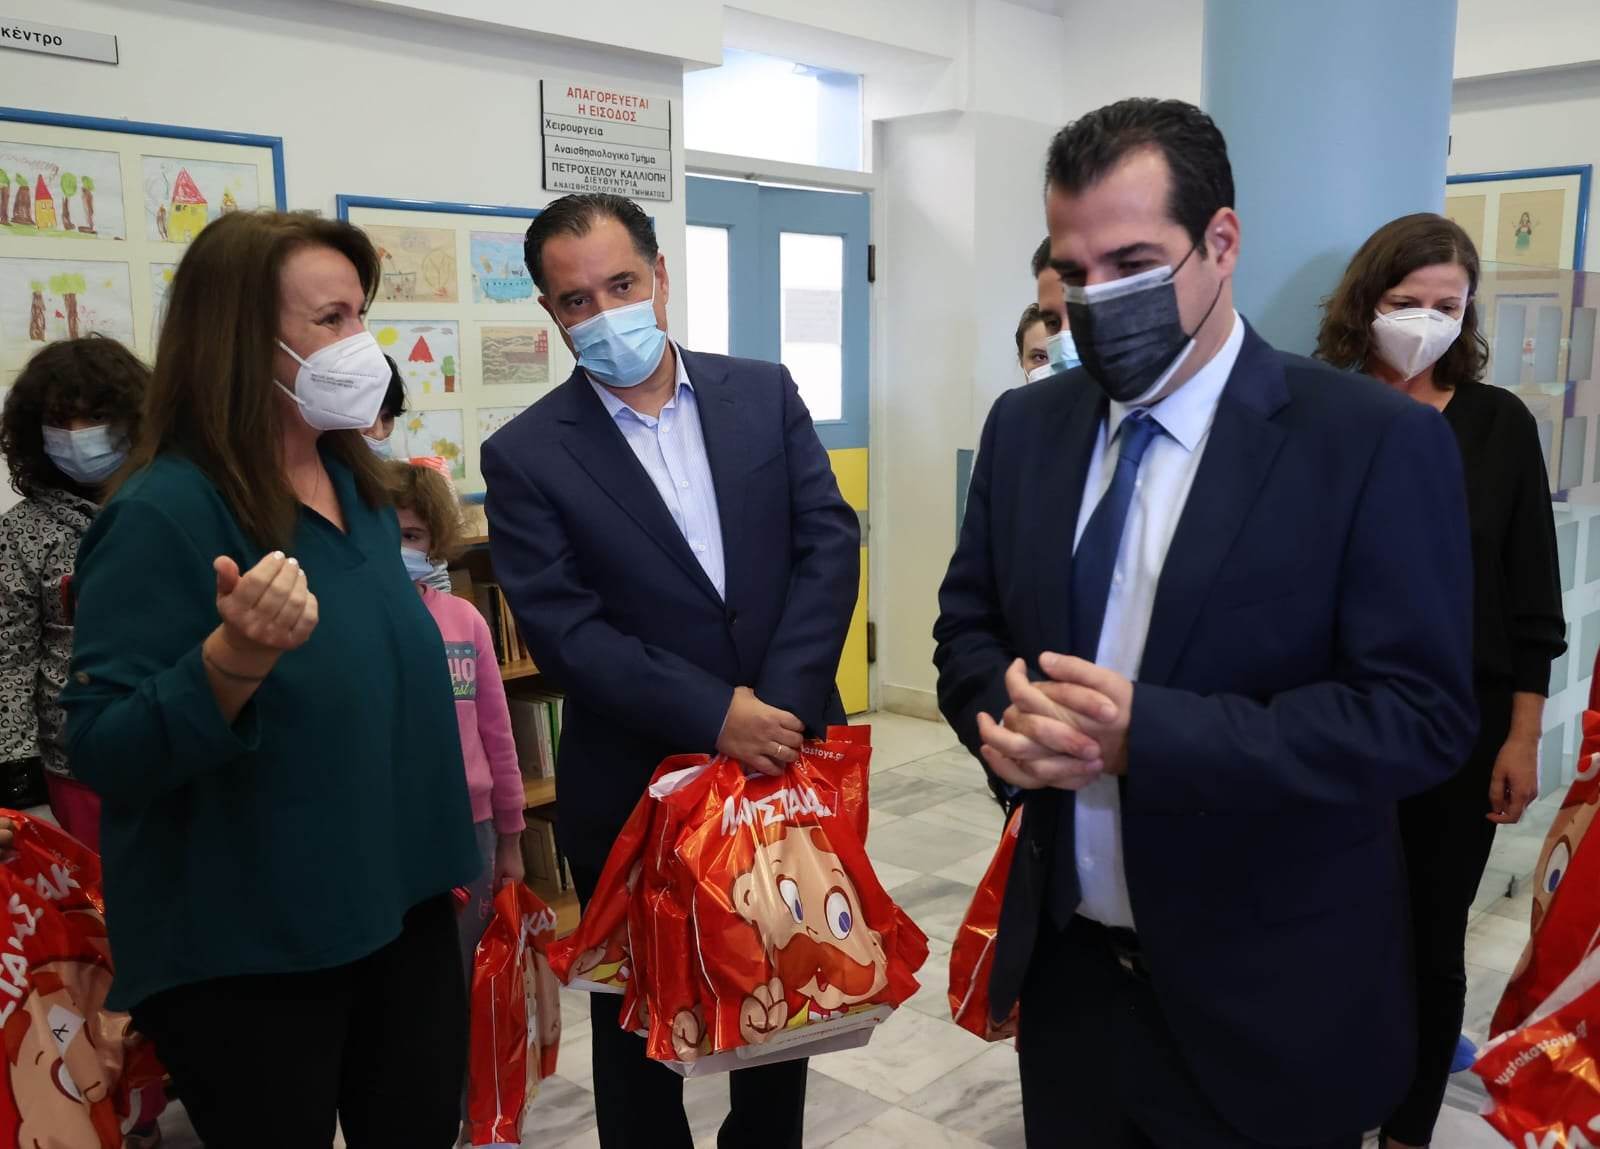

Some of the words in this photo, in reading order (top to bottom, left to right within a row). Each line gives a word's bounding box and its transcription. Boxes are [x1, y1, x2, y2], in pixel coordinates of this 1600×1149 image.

[1, 26, 63, 46] κέντρο
[567, 86, 649, 109] ΑΠΑΓΟΡΕΥΕΤΑΙ
[578, 104, 586, 115] Η
[590, 105, 637, 122] ΕΙΣΟΔΟΣ
[552, 162, 617, 177] ΠΕΤΡΟΧΕΙΛΟΥ
[620, 169, 667, 182] ΚΑΛΛΙΟΠΗ
[584, 176, 638, 187] ΔΙΕΥΘΥΝΤΡΙΑ
